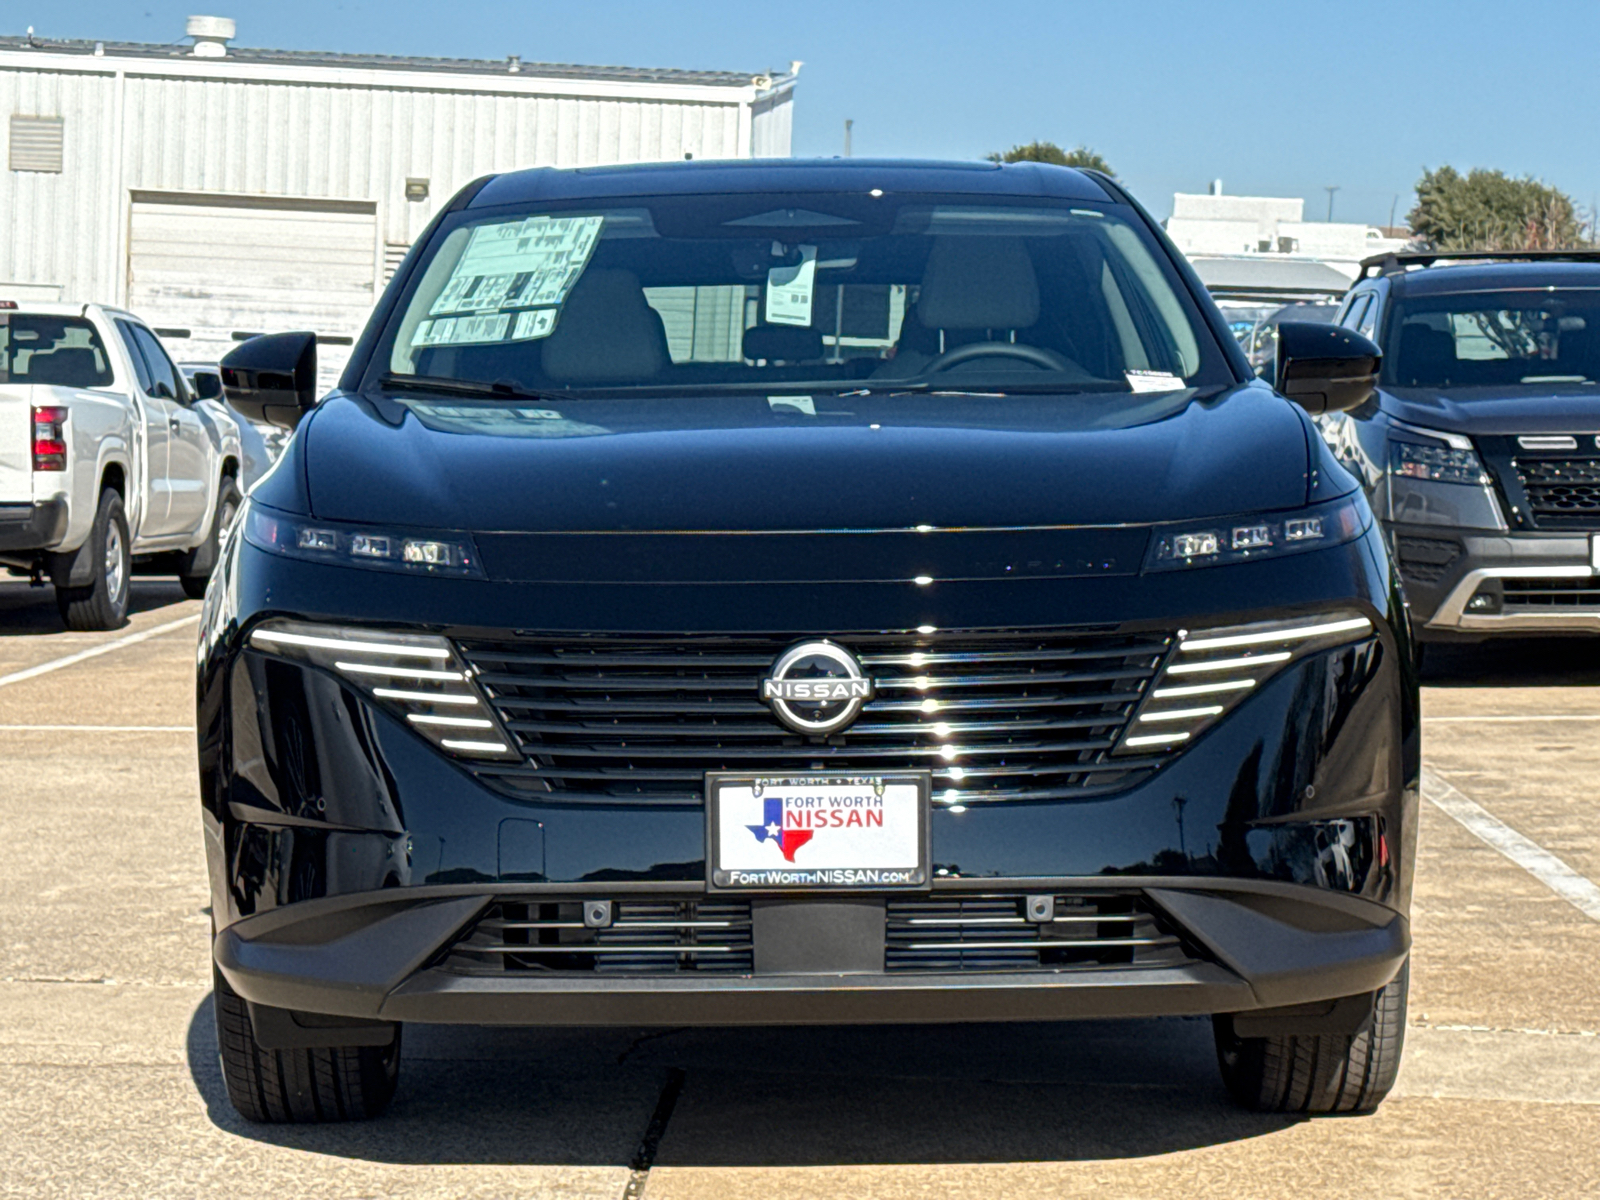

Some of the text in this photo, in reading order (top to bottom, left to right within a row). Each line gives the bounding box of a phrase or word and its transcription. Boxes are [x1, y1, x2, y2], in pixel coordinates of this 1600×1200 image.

[765, 681, 869, 697] NISSAN
[755, 776, 882, 786] FORT WORTH TEXAS
[785, 796, 883, 808] FORT WORTH
[786, 809, 883, 828] NISSAN
